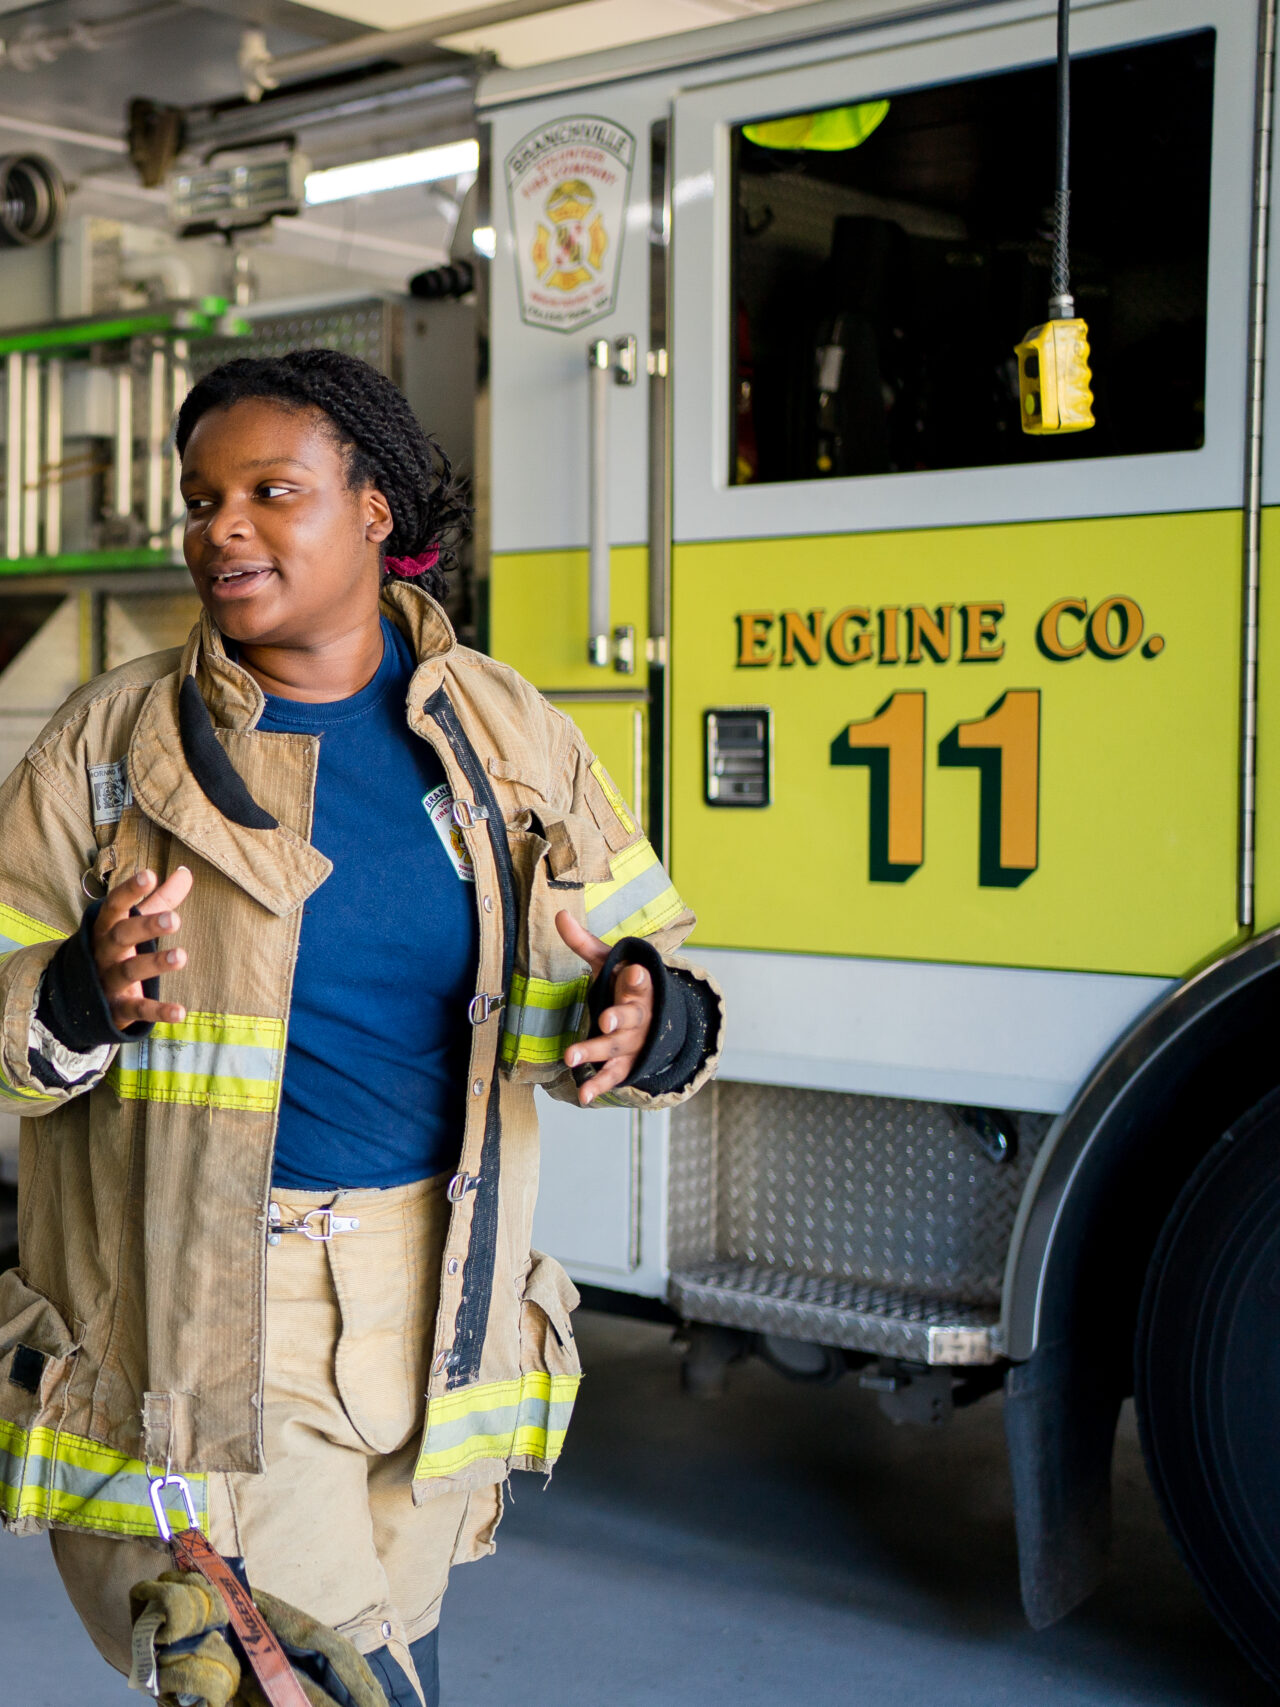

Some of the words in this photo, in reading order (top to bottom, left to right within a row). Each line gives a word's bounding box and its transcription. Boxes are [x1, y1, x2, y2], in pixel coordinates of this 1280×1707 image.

[734, 603, 1006, 669] ENGINE
[1036, 595, 1165, 662] CO.
[830, 688, 1041, 889] 11
